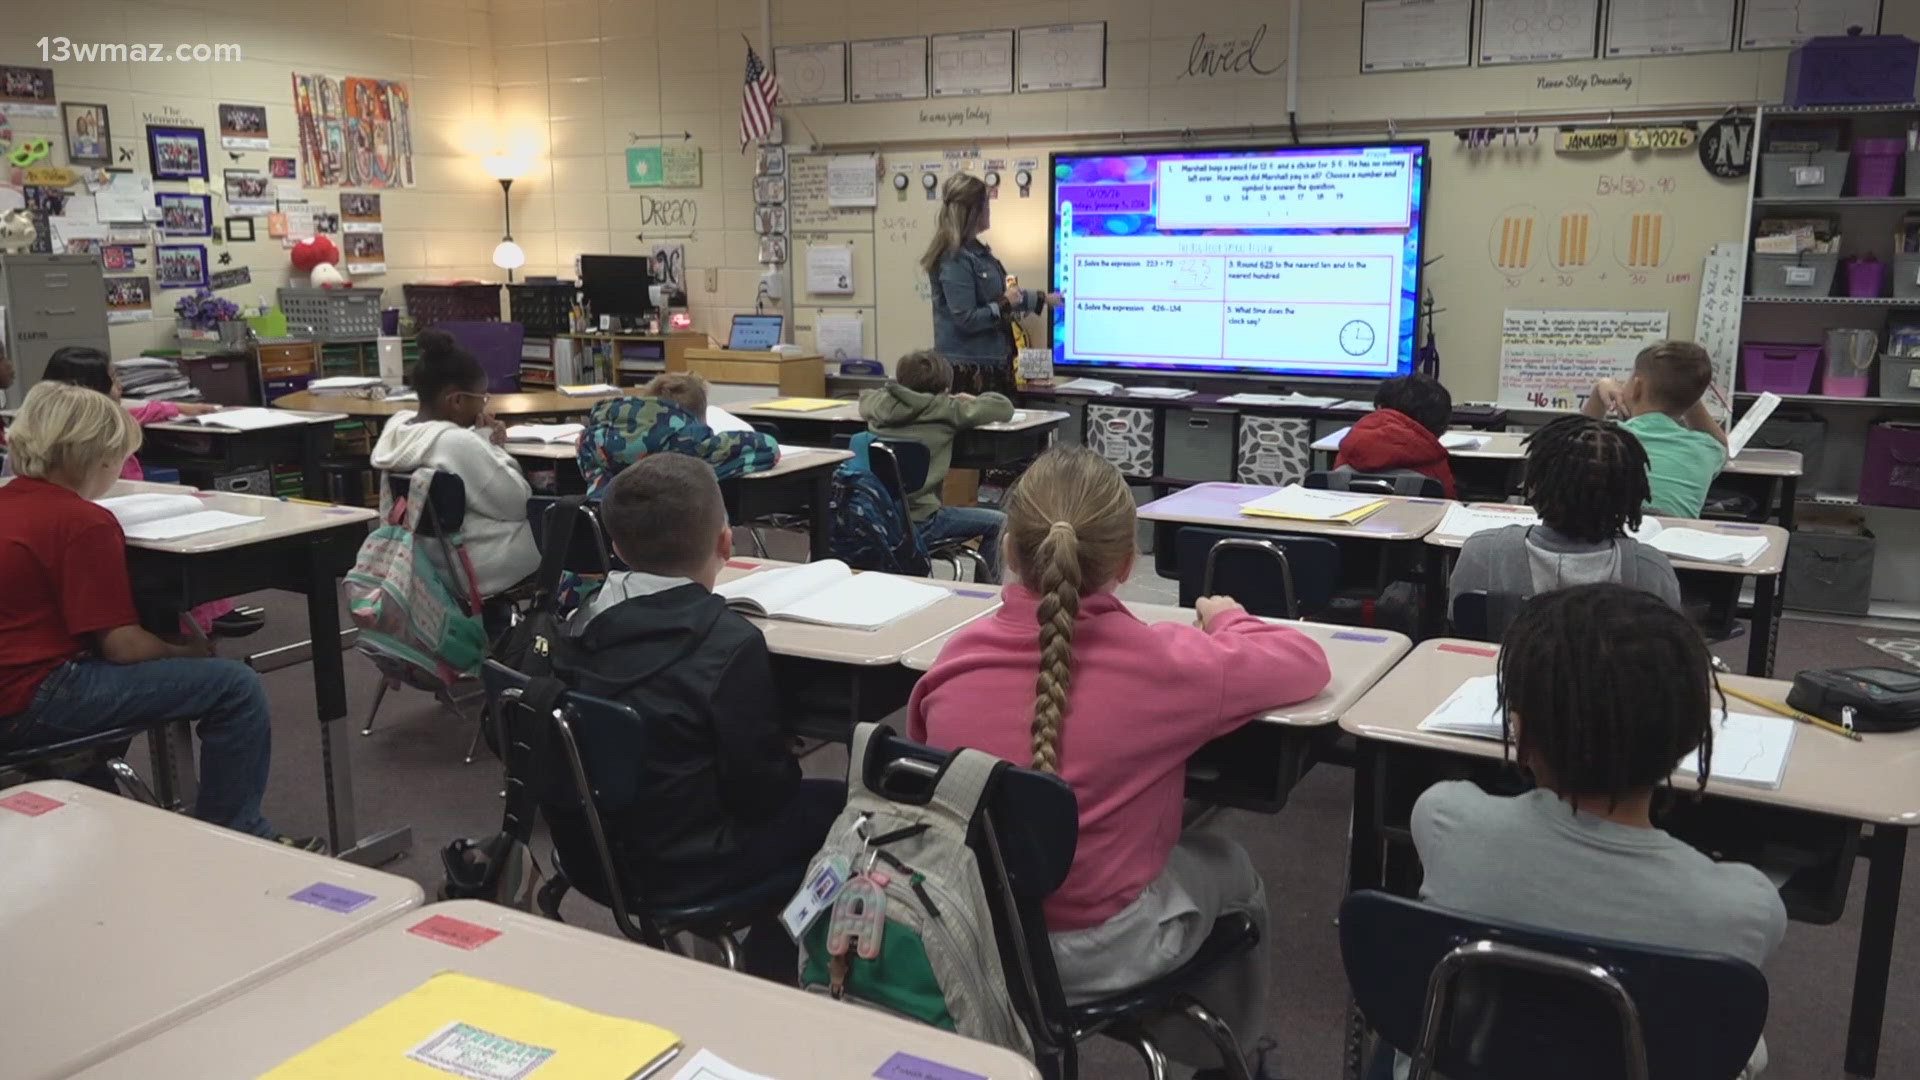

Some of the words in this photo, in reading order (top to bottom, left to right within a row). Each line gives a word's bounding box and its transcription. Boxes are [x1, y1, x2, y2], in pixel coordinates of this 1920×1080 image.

[1176, 23, 1288, 80] loved
[1537, 75, 1563, 88] Never
[1565, 74, 1587, 91] Stop
[1590, 72, 1632, 91] Dreaming
[162, 106, 181, 116] The
[966, 106, 990, 126] today
[142, 112, 195, 126] Memories
[1565, 131, 1618, 150] JANUARY
[1652, 129, 1689, 147] 2026
[1382, 160, 1405, 169] money
[1084, 303, 1101, 311] Solve
[1235, 306, 1251, 314] What
[1285, 307, 1295, 315] the
[1527, 392, 1548, 407] 46
